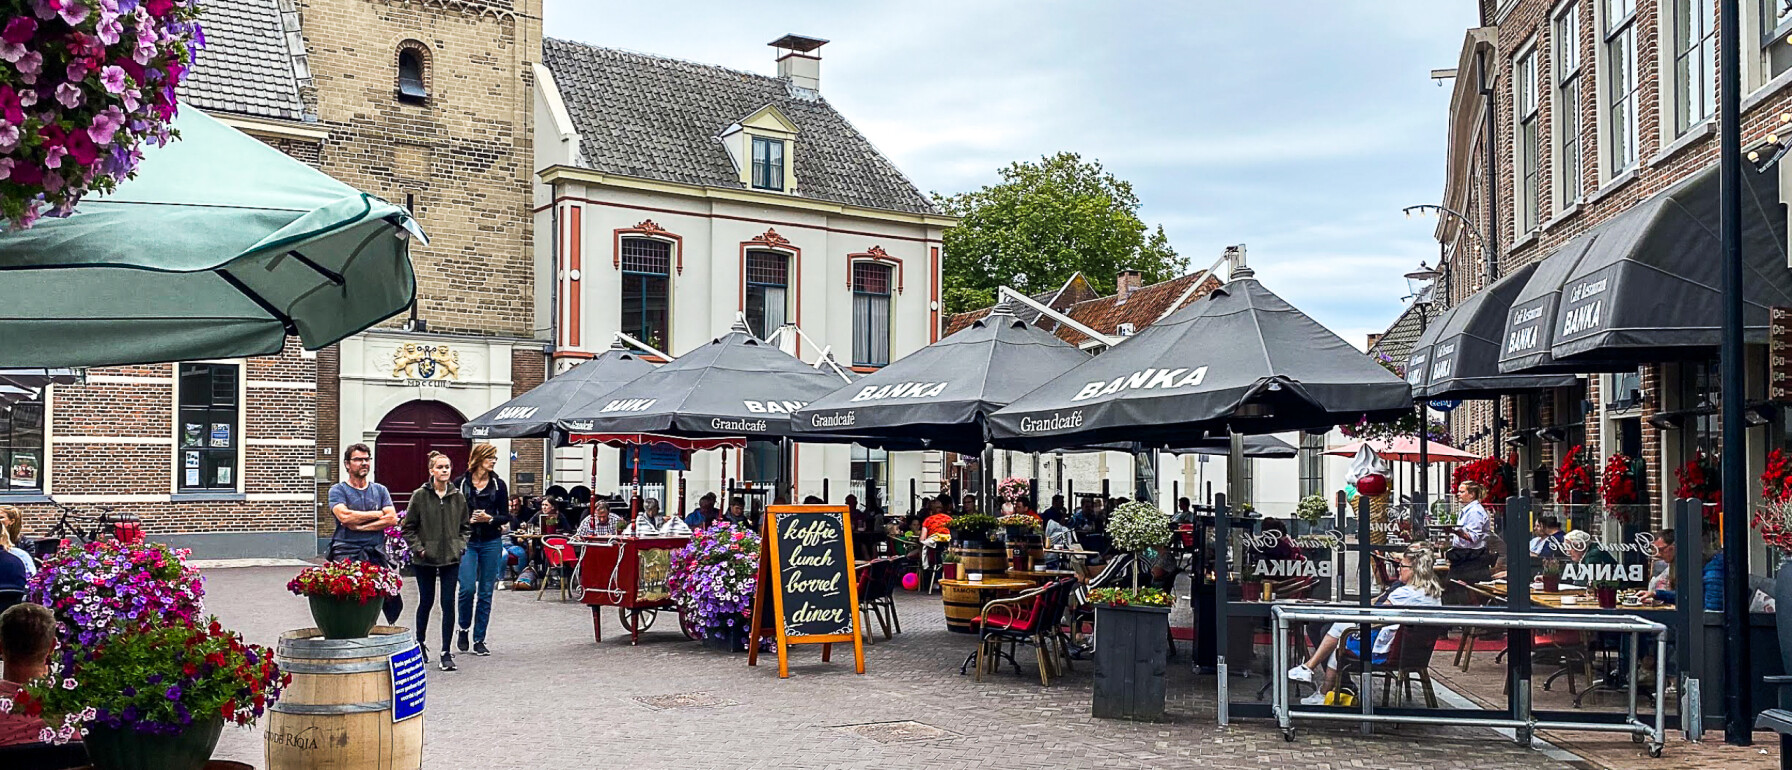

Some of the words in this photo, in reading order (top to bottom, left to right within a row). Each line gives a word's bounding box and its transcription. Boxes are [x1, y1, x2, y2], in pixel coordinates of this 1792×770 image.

[1563, 300, 1601, 337] BANKA
[1508, 325, 1538, 354] BANKA
[1432, 358, 1452, 380] BANKA
[850, 382, 949, 402] BANKA
[1071, 365, 1209, 402] BANKA
[494, 406, 539, 420] BANKA
[600, 398, 657, 413] BANKA
[711, 417, 767, 431] Grandcafé
[811, 411, 855, 427] Grandcafé
[1020, 410, 1083, 432] Grandcafé
[783, 518, 838, 546] koffie
[1370, 522, 1400, 532] ANKA
[788, 545, 835, 567] lunch
[785, 570, 841, 593] borrel
[792, 601, 845, 623] diner
